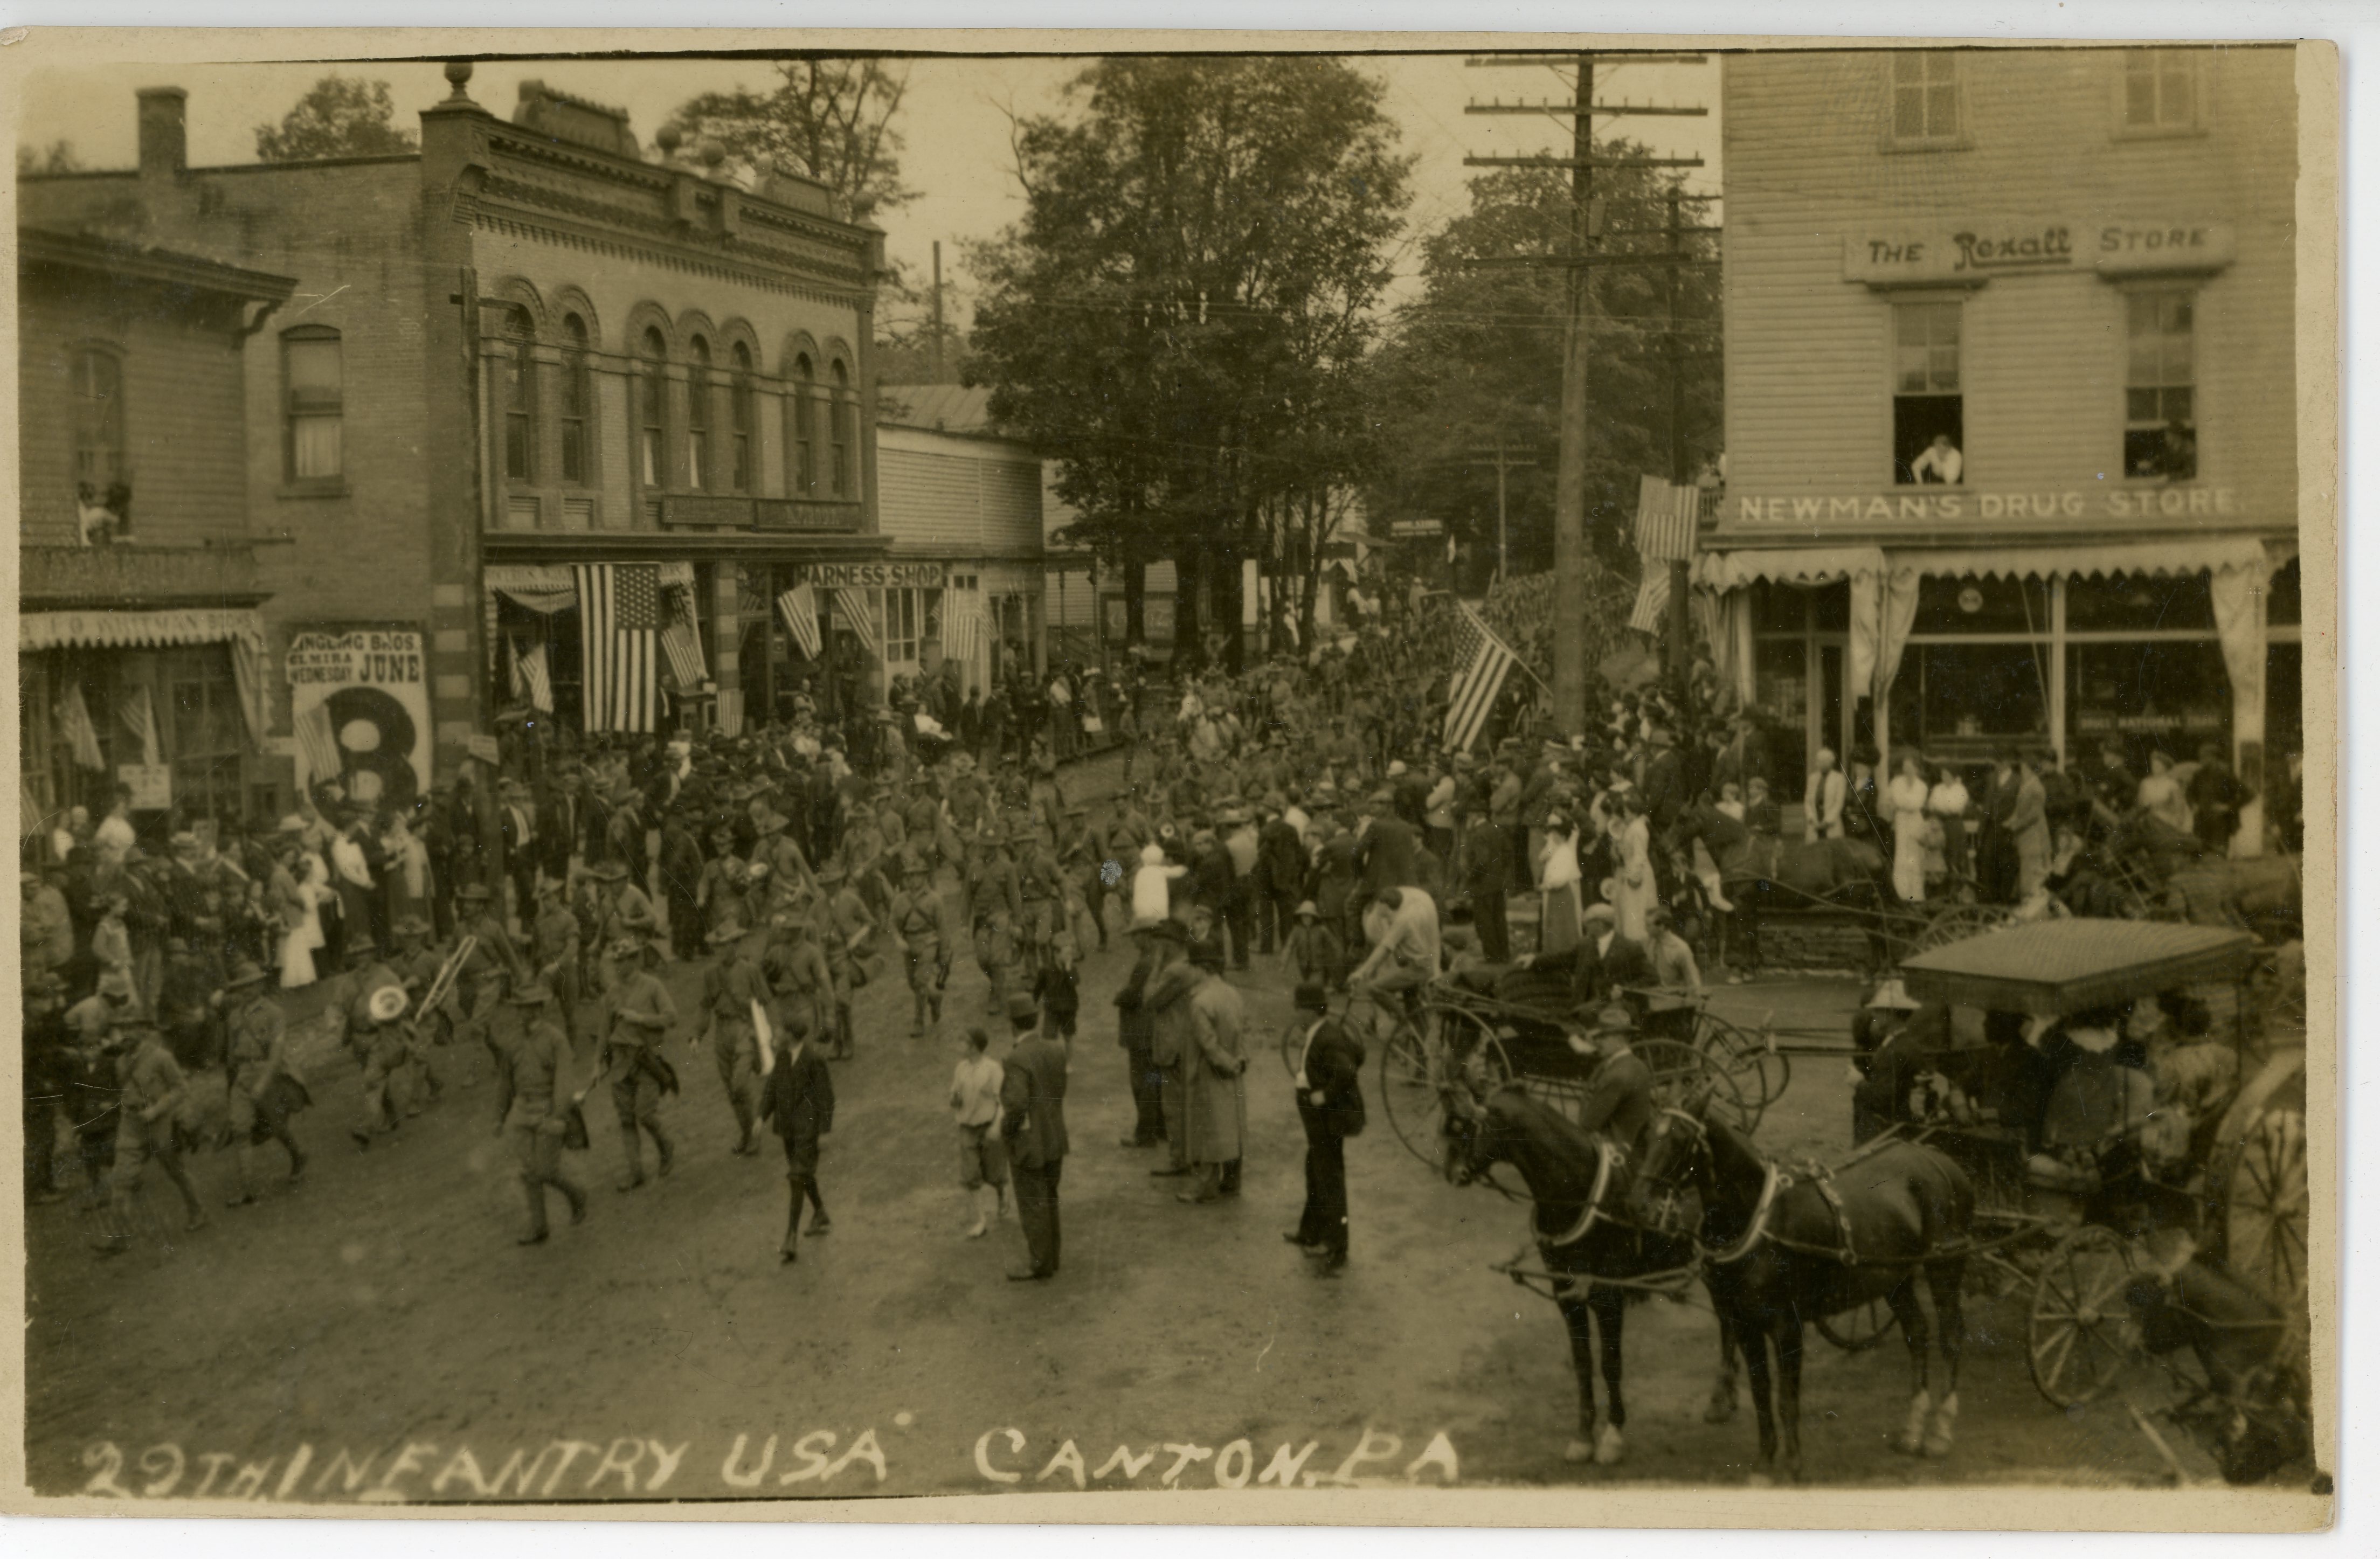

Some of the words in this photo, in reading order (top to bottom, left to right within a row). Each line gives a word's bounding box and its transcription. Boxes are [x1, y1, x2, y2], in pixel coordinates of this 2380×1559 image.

[1868, 240, 1924, 263] THE
[1953, 227, 2072, 271] Rexall
[2103, 227, 2205, 252] STORE
[1740, 495, 1961, 521] NEWMAN'S
[1981, 493, 2082, 517] DRUG
[890, 565, 940, 586] SHOP
[289, 653, 351, 665] ELMIRA
[359, 654, 419, 683] JUNE
